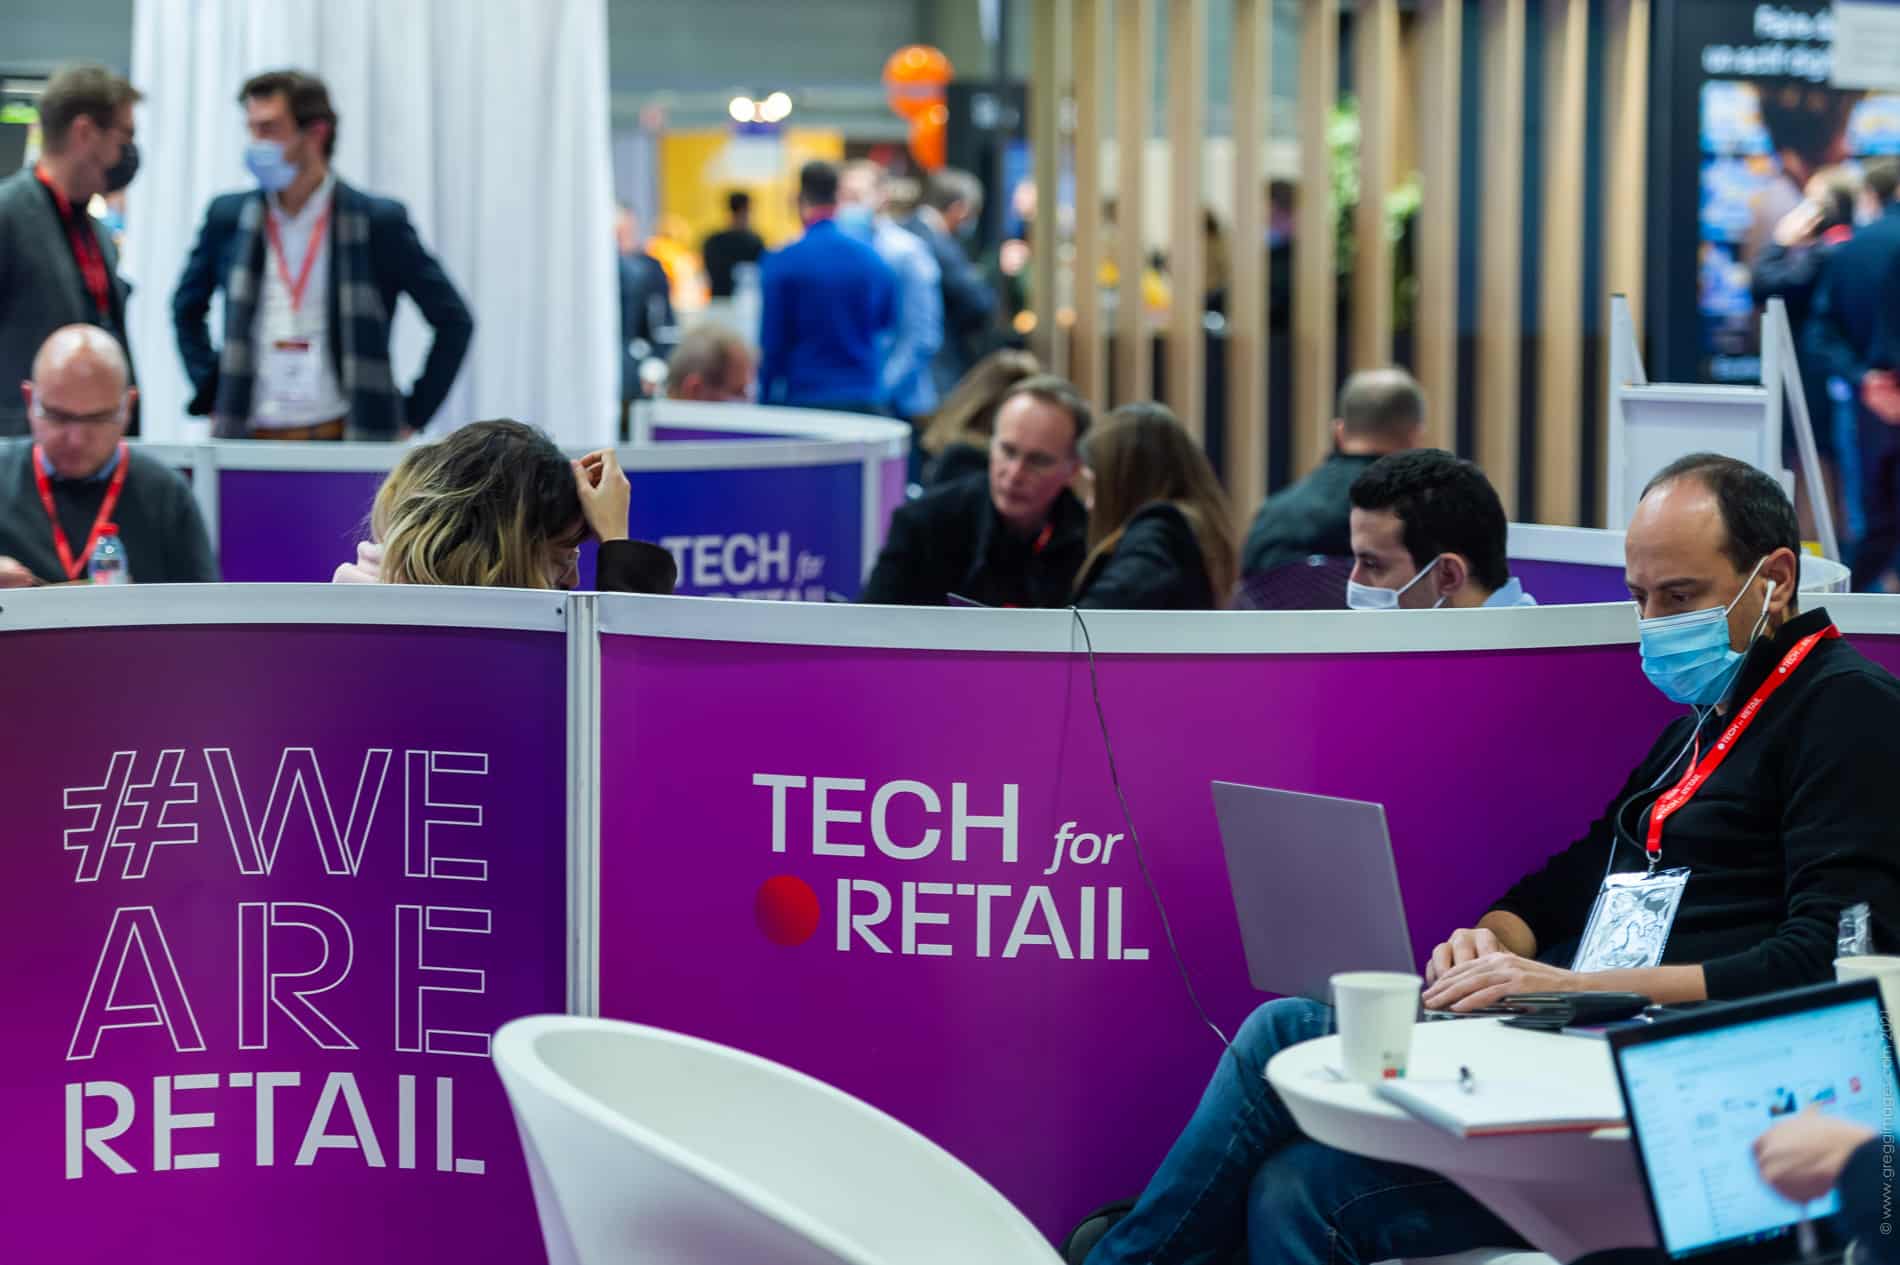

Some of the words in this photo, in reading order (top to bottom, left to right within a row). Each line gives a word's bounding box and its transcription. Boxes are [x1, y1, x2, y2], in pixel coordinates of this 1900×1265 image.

[660, 531, 790, 588] TECH
[1721, 724, 1740, 743] TECH
[64, 747, 489, 882] #WE
[752, 773, 1019, 863] TECH
[1043, 821, 1124, 875] for
[836, 878, 1150, 961] RETAIL
[66, 902, 492, 1060] ARE
[65, 1071, 486, 1179] RETAIL
